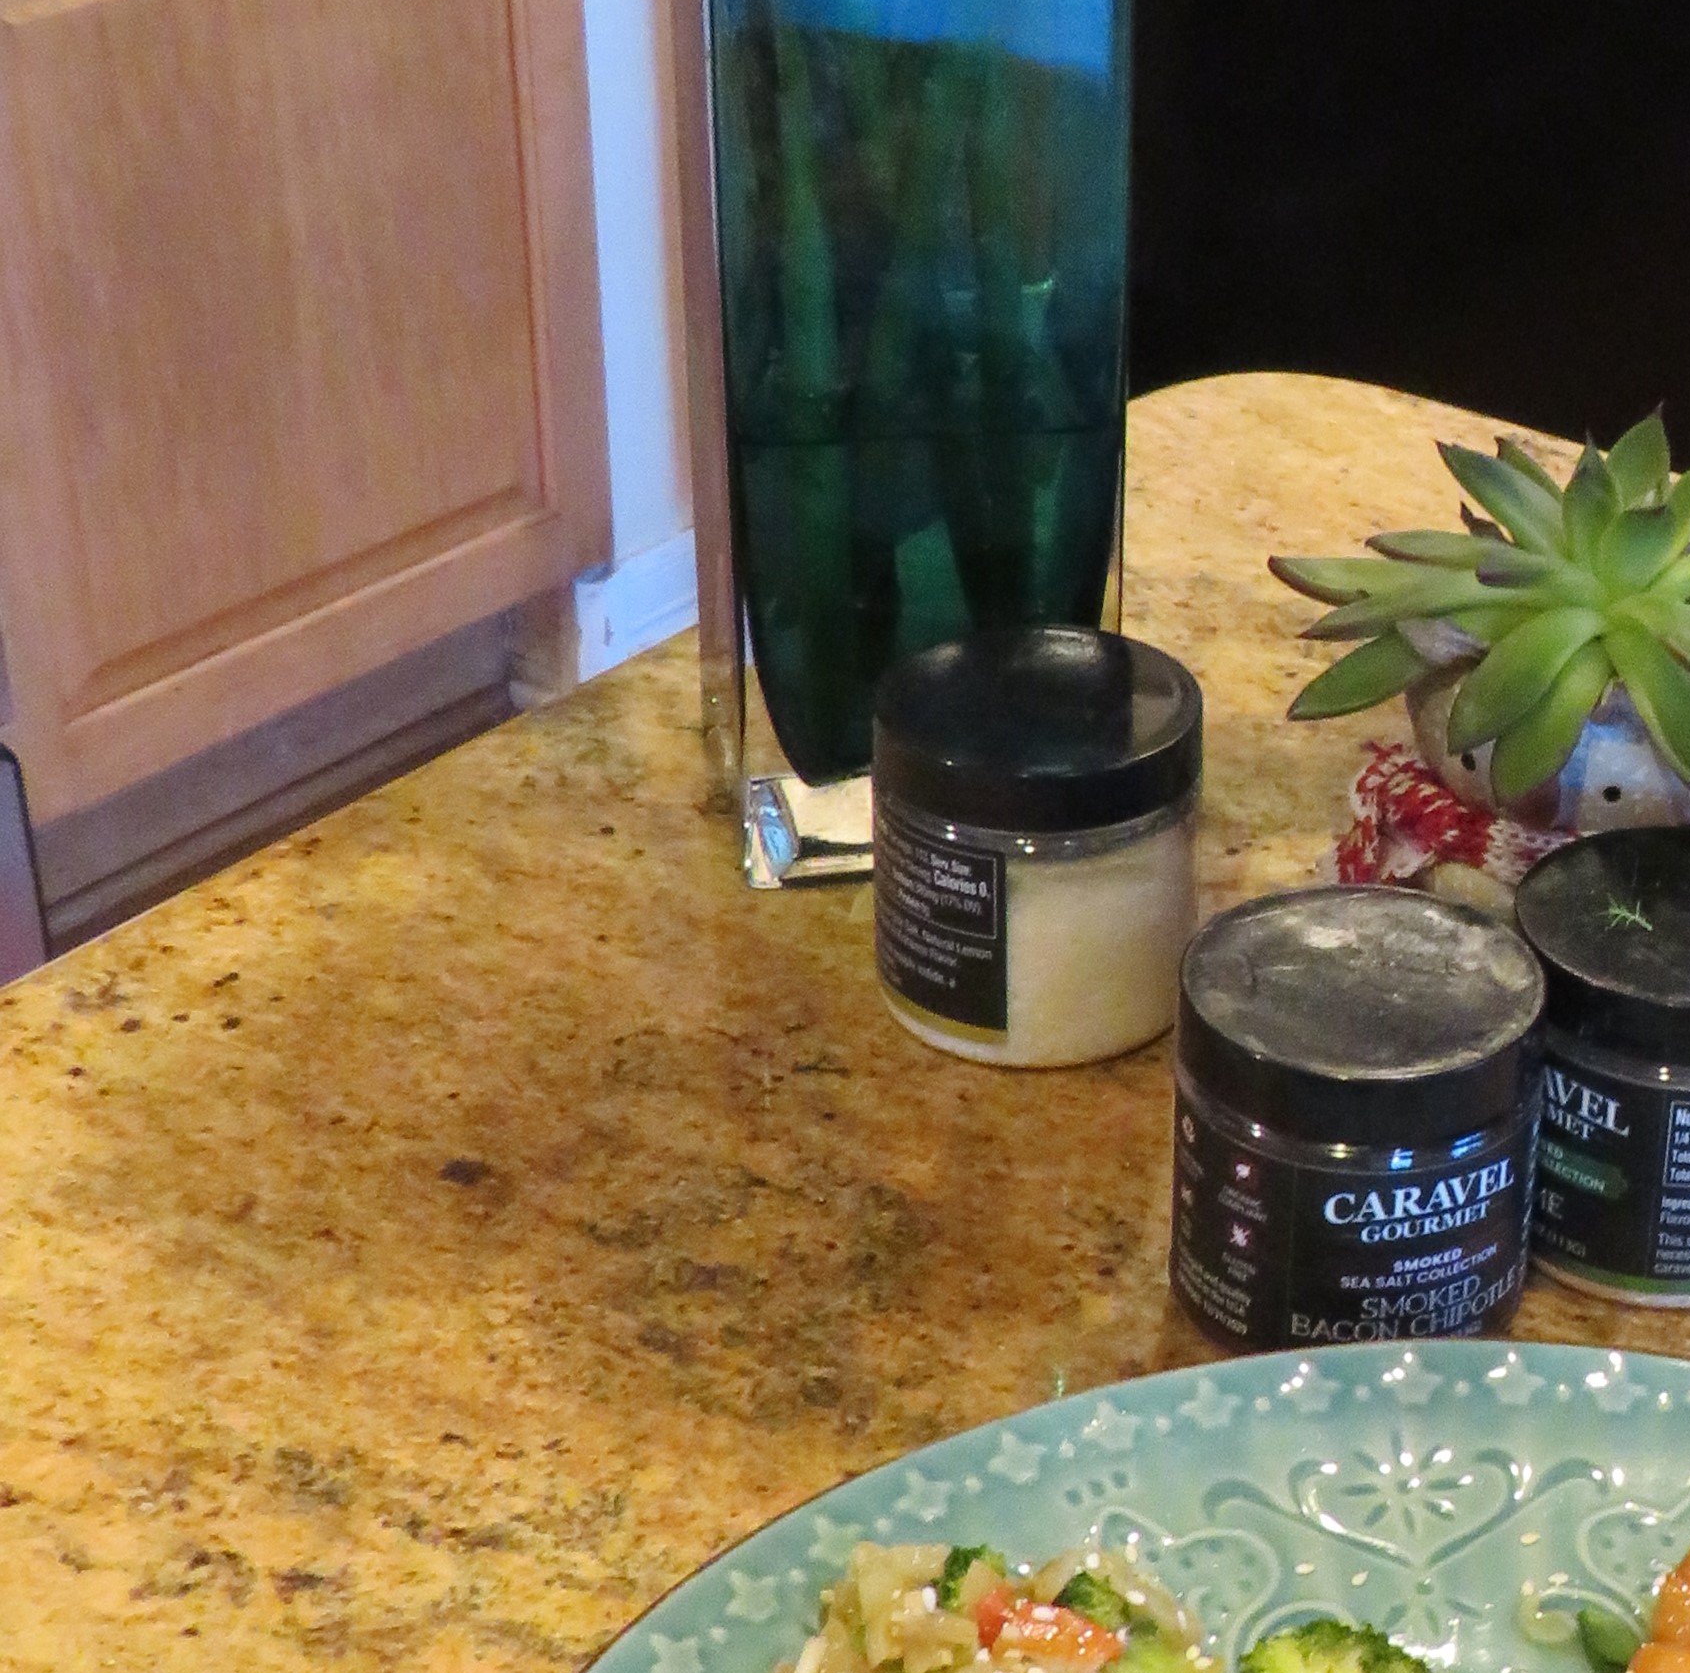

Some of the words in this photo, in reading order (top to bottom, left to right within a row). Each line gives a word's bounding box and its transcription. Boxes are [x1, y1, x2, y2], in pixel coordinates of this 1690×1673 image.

[1323, 1157, 1515, 1225] CARAVEL
[1360, 1200, 1491, 1243] GOURMET
[1340, 1275, 1371, 1290] SEA
[1375, 1273, 1411, 1288] SALT
[1416, 1242, 1498, 1283] COLLECTION
[1393, 1246, 1463, 1273] SMOKED
[1290, 1312, 1399, 1340] BACON
[1409, 1263, 1517, 1336] CHIPOTLE
[1360, 1275, 1481, 1319] SMOKED
